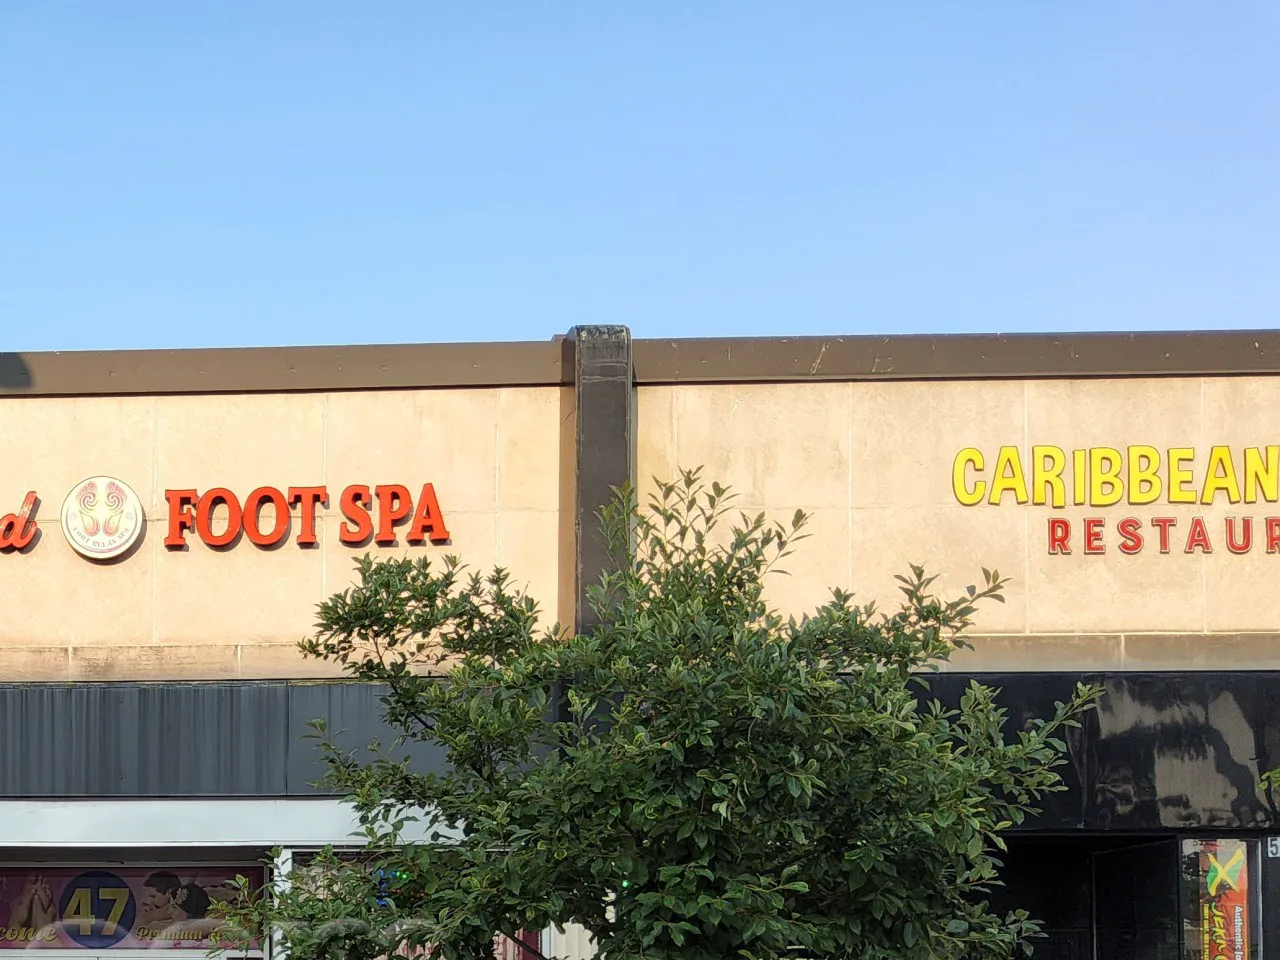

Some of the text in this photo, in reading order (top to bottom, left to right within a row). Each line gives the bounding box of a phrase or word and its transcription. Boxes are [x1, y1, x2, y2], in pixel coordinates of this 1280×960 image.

[952, 445, 1280, 508] CARIBBEAN
[164, 486, 327, 548] FOOT
[339, 482, 450, 544] SPA
[1270, 837, 1279, 856] 5
[62, 887, 130, 936] 47
[136, 926, 204, 942] Premium
[1234, 904, 1244, 950] Authentic
